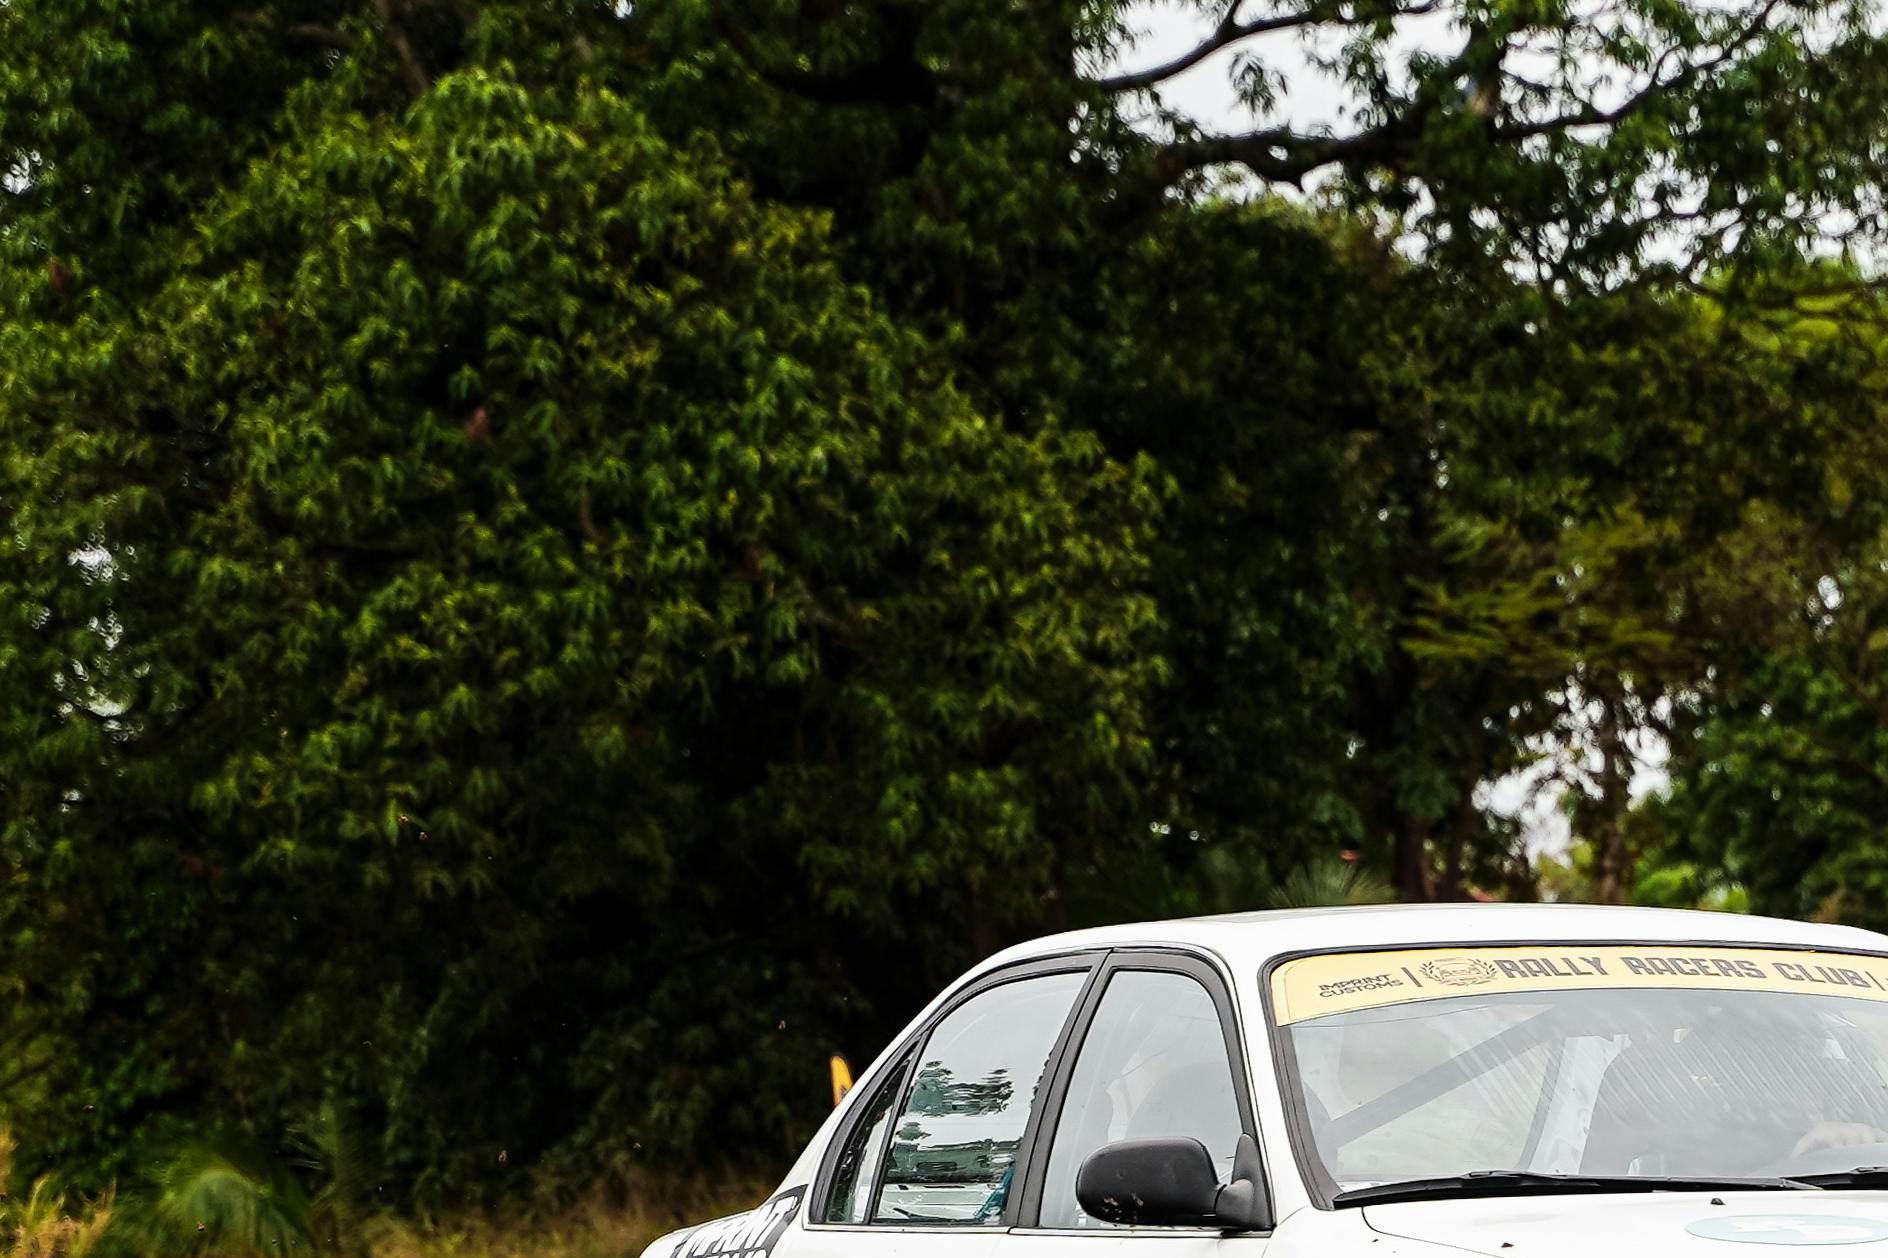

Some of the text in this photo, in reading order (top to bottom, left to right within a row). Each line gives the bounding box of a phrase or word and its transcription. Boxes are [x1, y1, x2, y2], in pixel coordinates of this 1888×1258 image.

[1493, 956, 1871, 988] RALLY RACERS CLUB
[1318, 974, 1393, 992] IMPRINT
[1319, 979, 1404, 998] CUSTOMS
